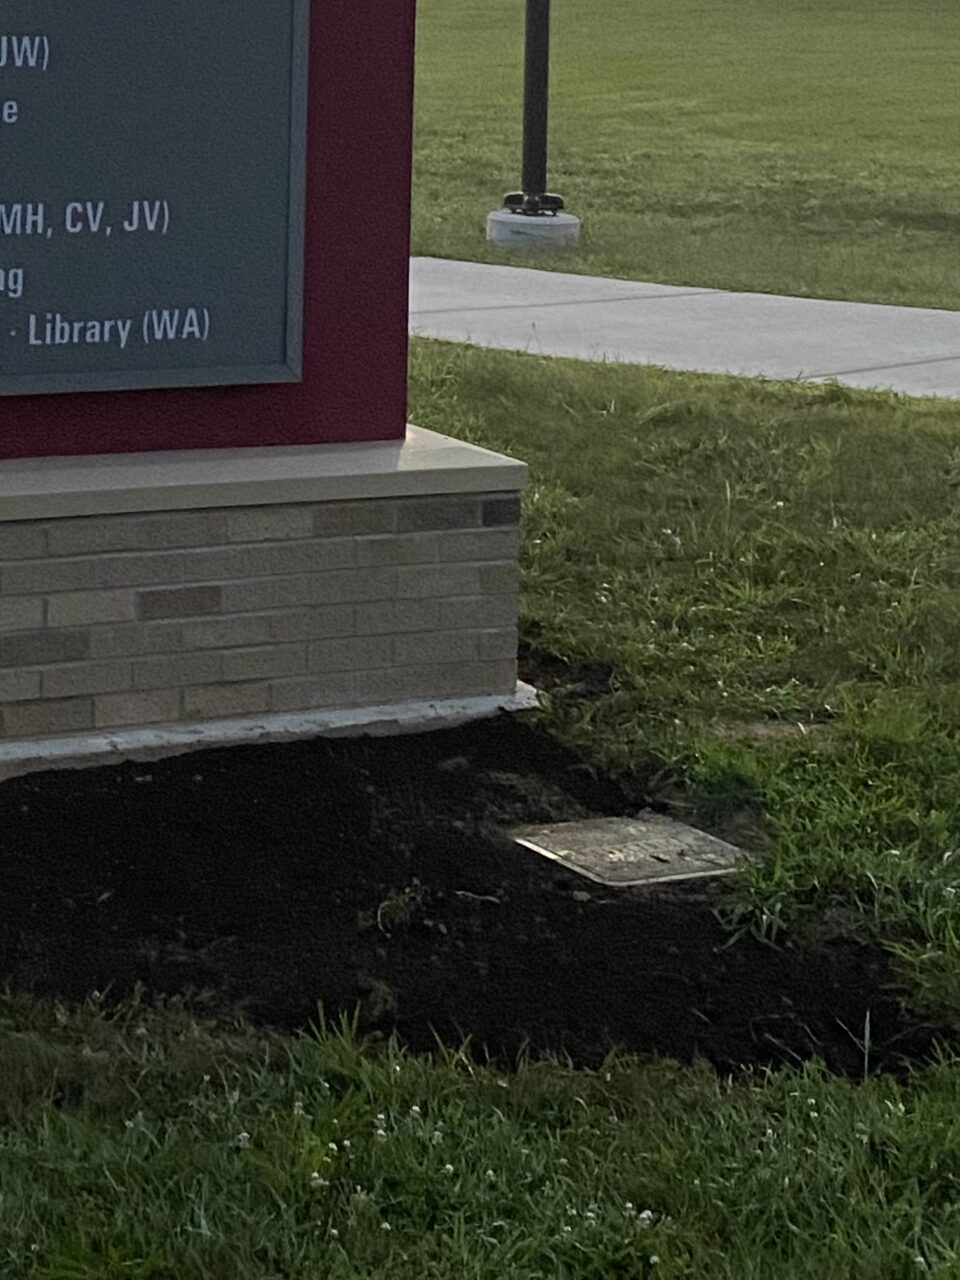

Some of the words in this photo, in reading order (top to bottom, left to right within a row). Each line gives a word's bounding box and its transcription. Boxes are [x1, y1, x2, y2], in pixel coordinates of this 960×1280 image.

[65, 201, 112, 236] CV,
[123, 200, 169, 234] JV)
[29, 313, 132, 349] Library
[142, 308, 210, 344] (WA)
